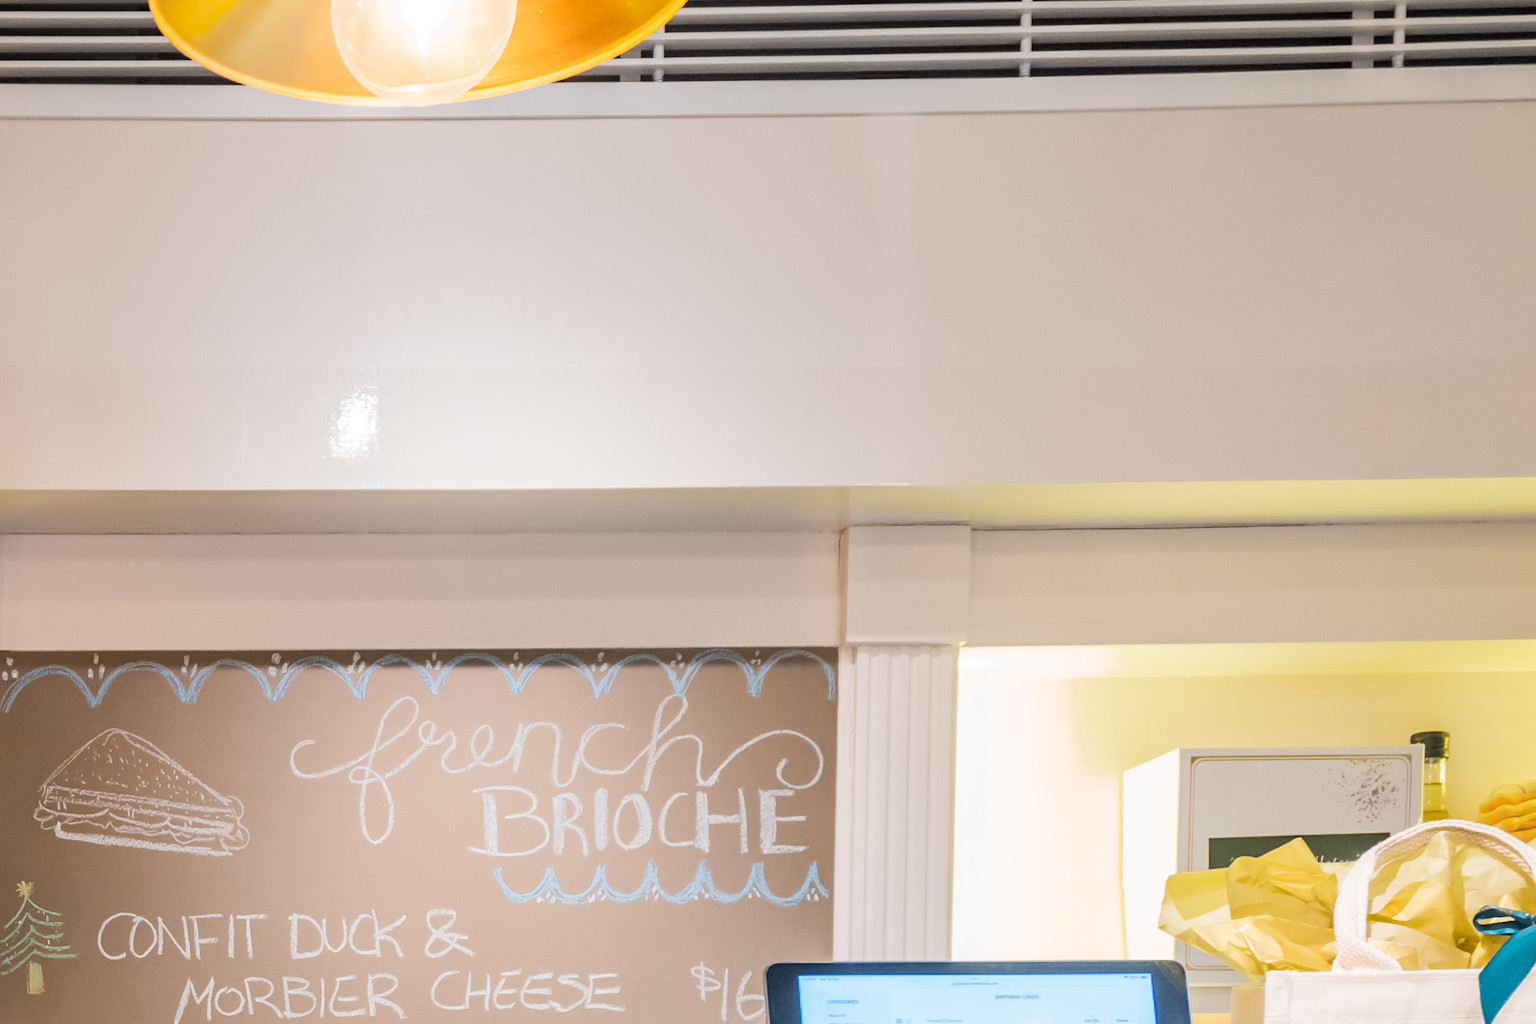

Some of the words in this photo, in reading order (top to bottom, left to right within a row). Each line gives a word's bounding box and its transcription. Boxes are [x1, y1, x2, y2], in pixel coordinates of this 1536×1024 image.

[290, 694, 824, 844] french
[467, 785, 810, 858] BRIOCHE
[97, 911, 268, 961] CONFIT
[288, 907, 408, 959] DUCK
[424, 908, 476, 958] &
[429, 968, 627, 1013] CHEESE
